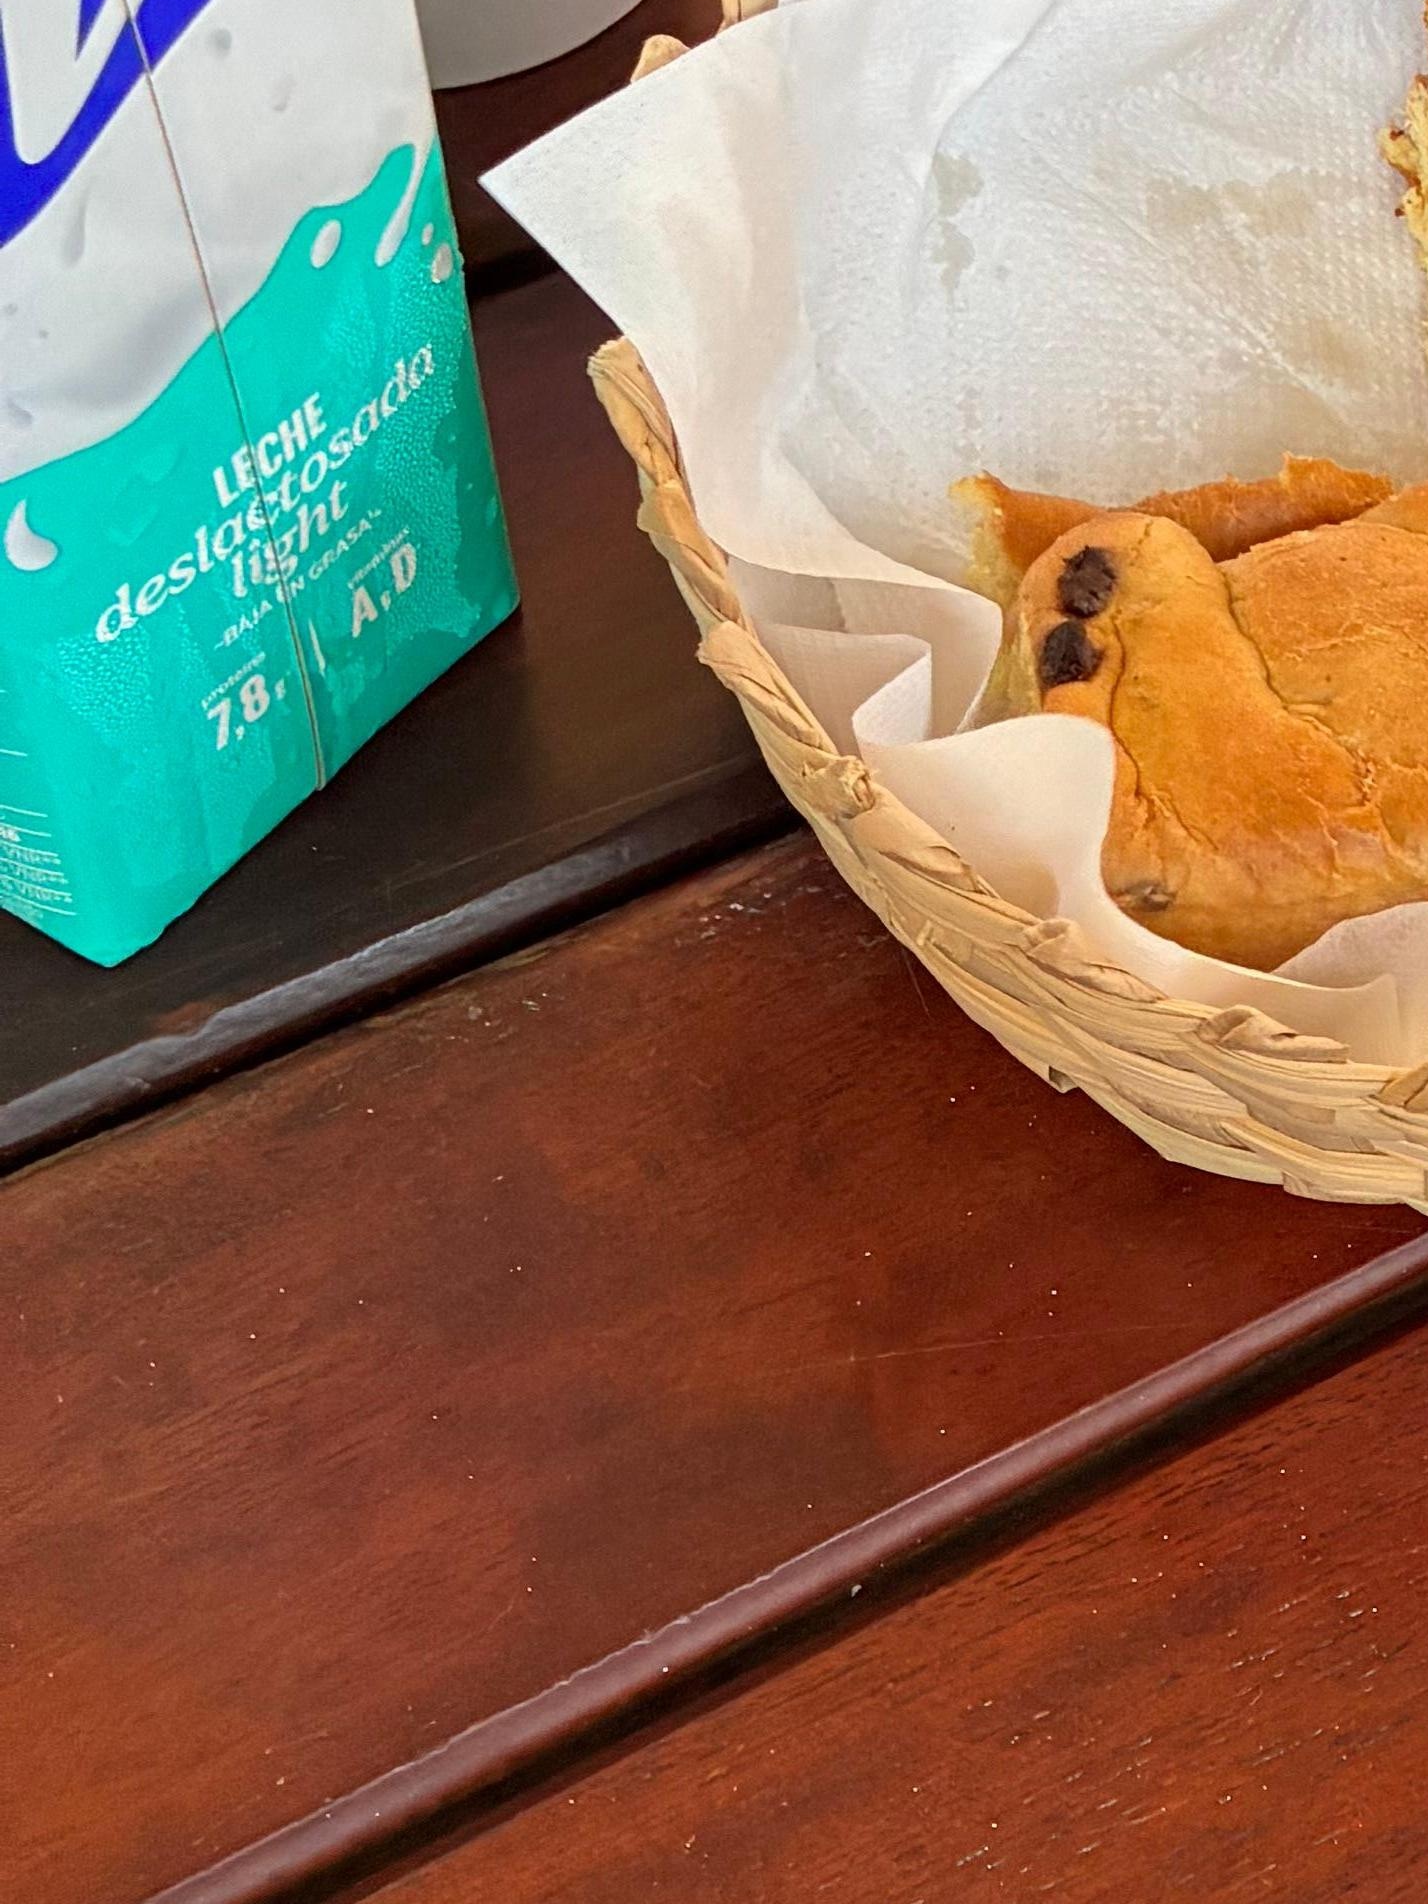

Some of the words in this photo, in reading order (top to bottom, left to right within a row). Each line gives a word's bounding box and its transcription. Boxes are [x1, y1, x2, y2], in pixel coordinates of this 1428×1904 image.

[96, 344, 433, 643] deslactosada
[213, 392, 328, 508] LECHE
[231, 479, 349, 598] light
